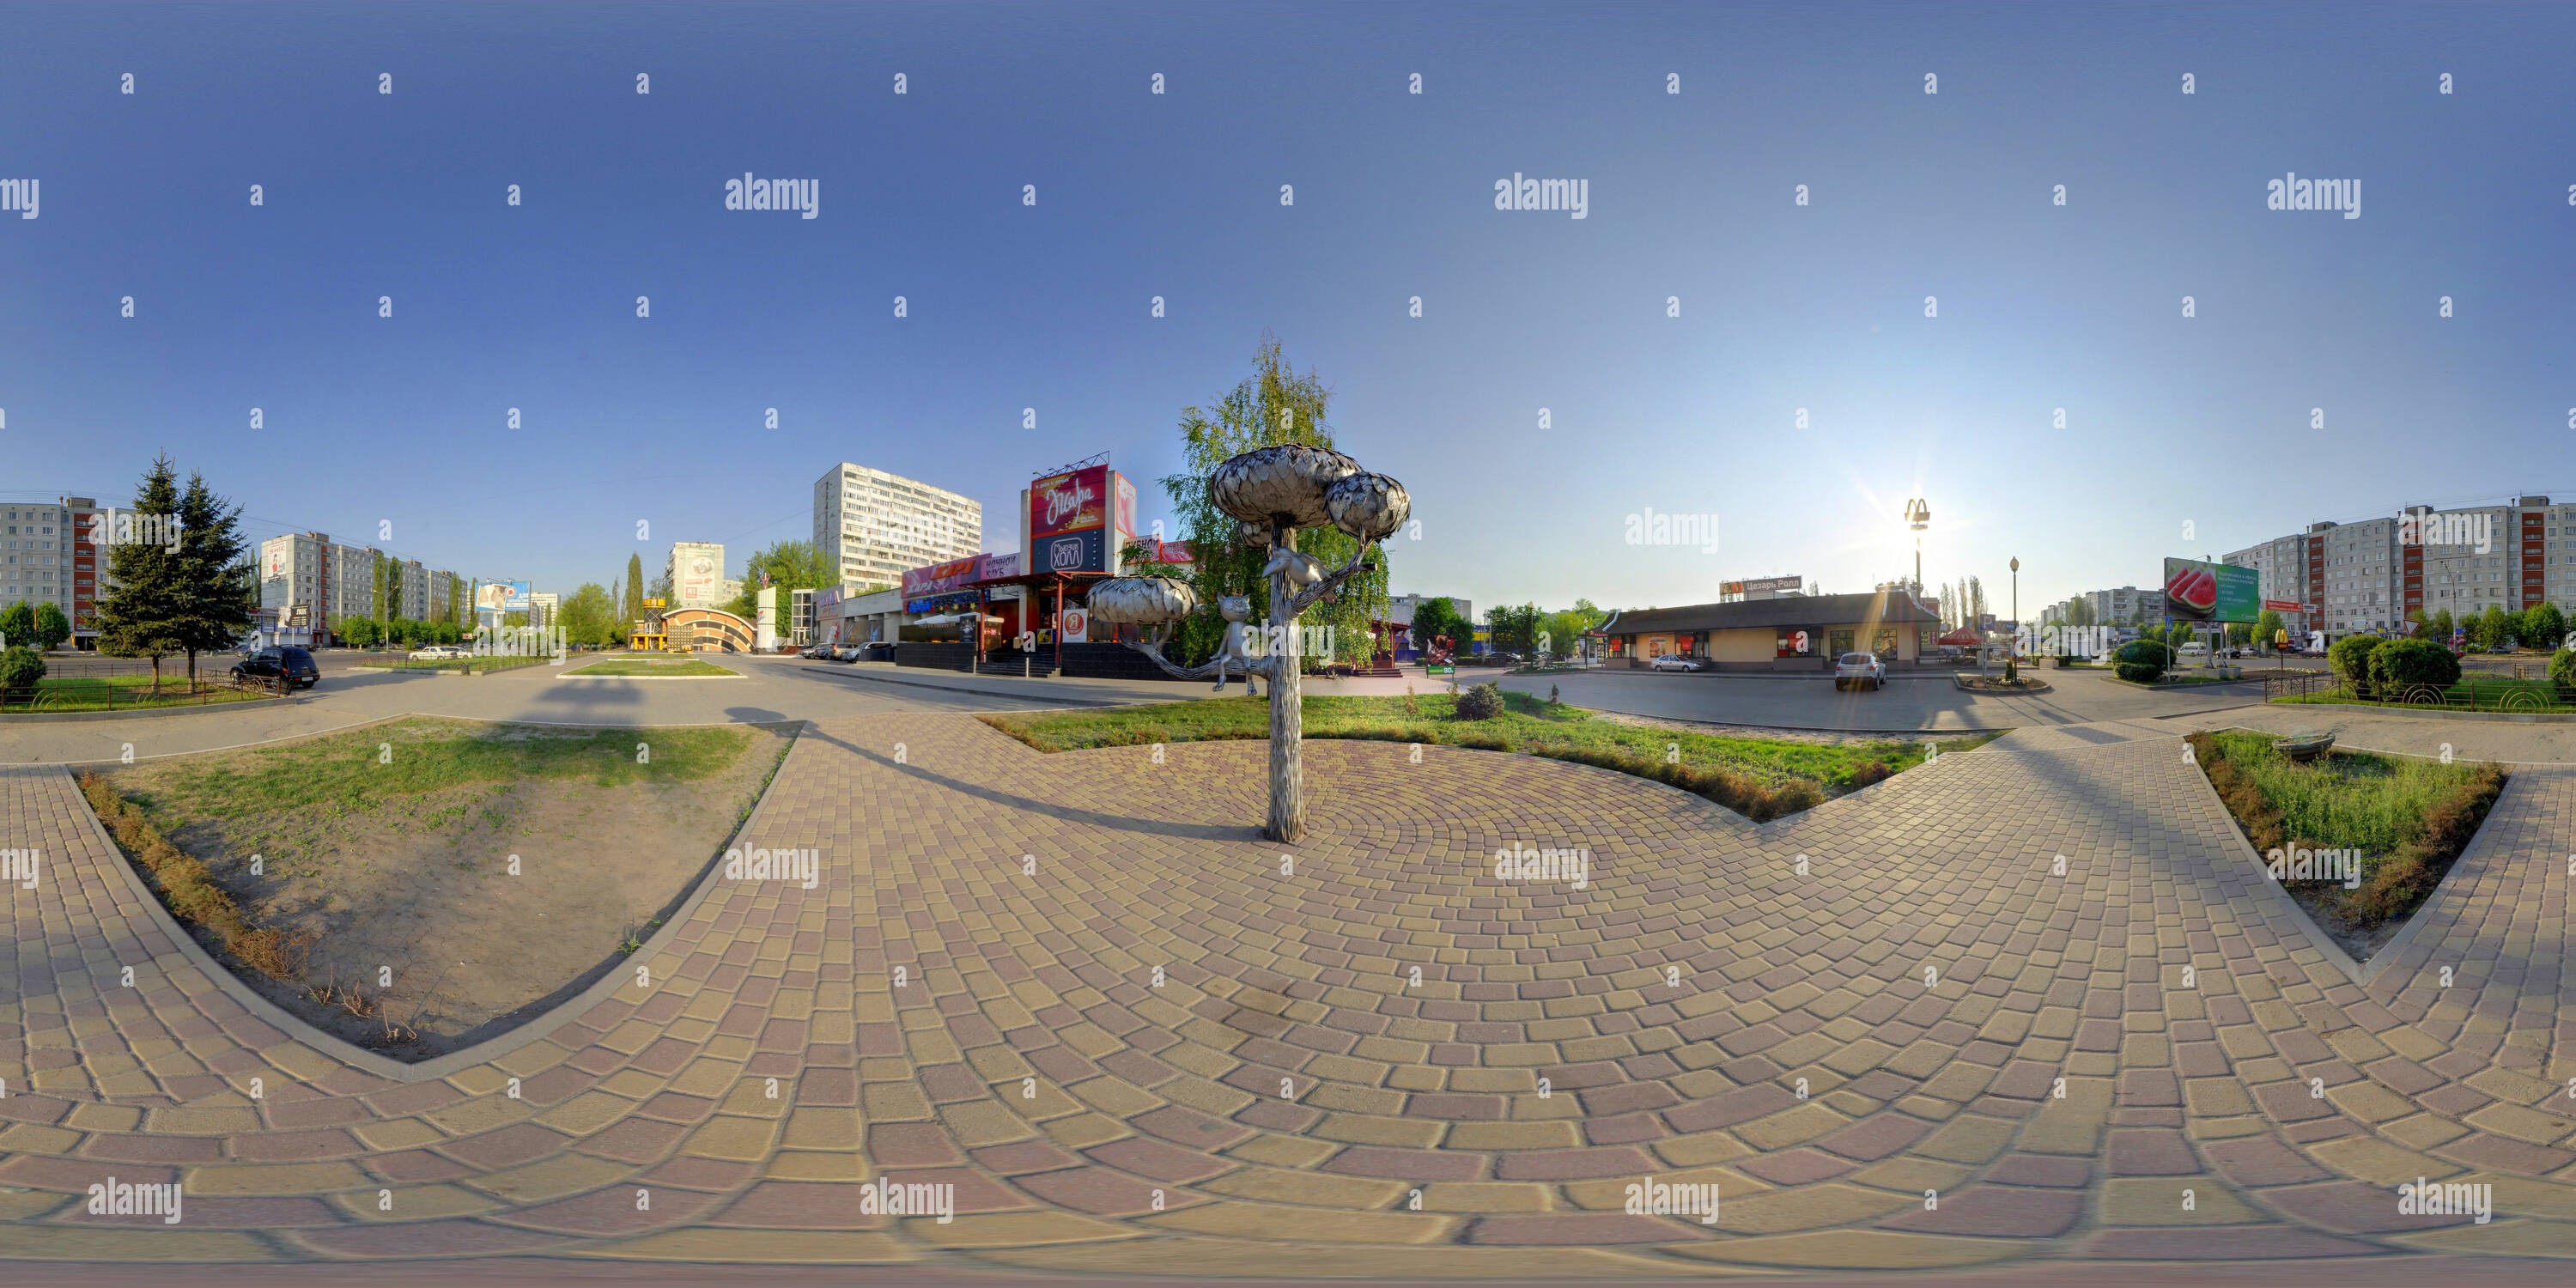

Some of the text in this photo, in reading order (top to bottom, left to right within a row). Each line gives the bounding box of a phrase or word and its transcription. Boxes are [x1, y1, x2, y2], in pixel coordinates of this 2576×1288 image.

[986, 556, 1017, 568] НОЧНОЙ
[1054, 550, 1080, 568] ХОЛЛ
[986, 568, 1005, 578] КЛУБ
[1747, 579, 1800, 592] Цезарь Ролл
[1984, 617, 1993, 629] P
